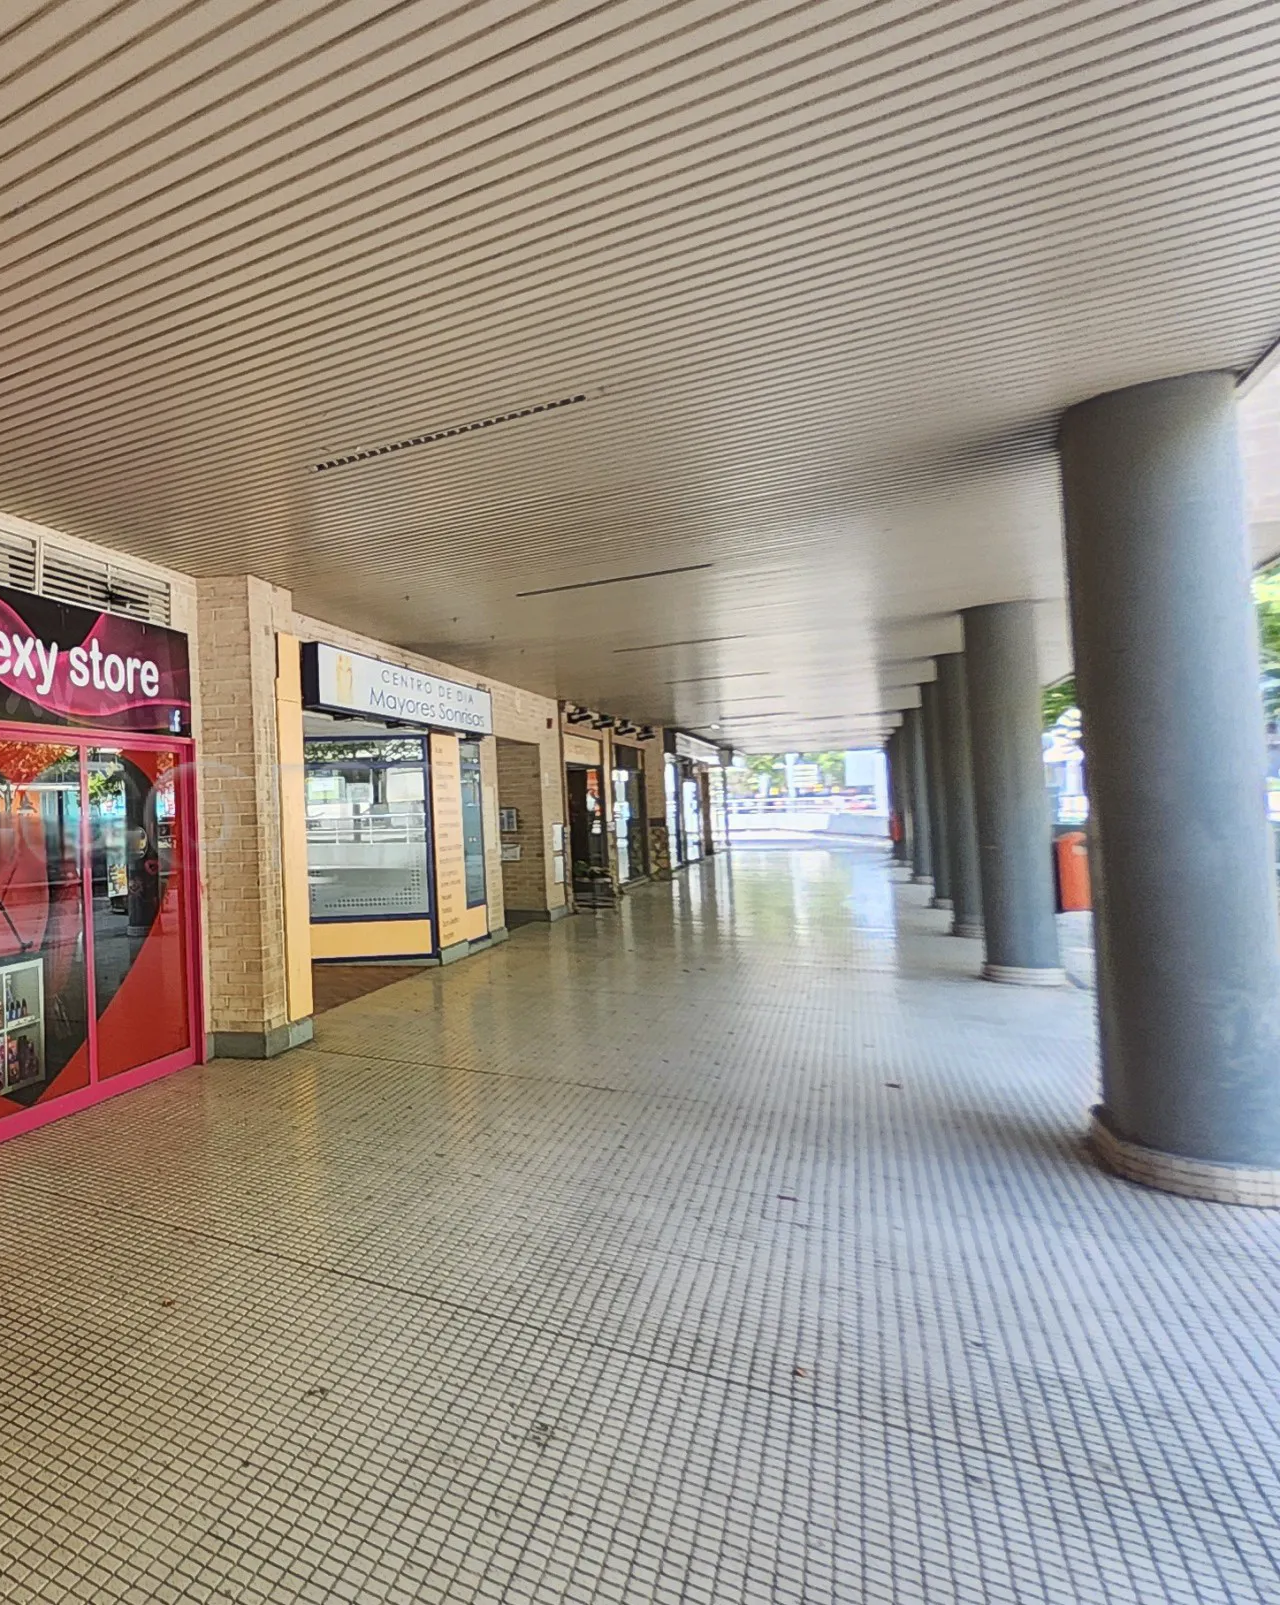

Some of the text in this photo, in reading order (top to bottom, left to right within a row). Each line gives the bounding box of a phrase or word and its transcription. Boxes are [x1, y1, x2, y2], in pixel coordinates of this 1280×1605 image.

[70, 638, 160, 697] store
[381, 669, 433, 694] CENTRO
[438, 685, 452, 699] DE
[370, 687, 485, 727] Mayores Sonrisas
